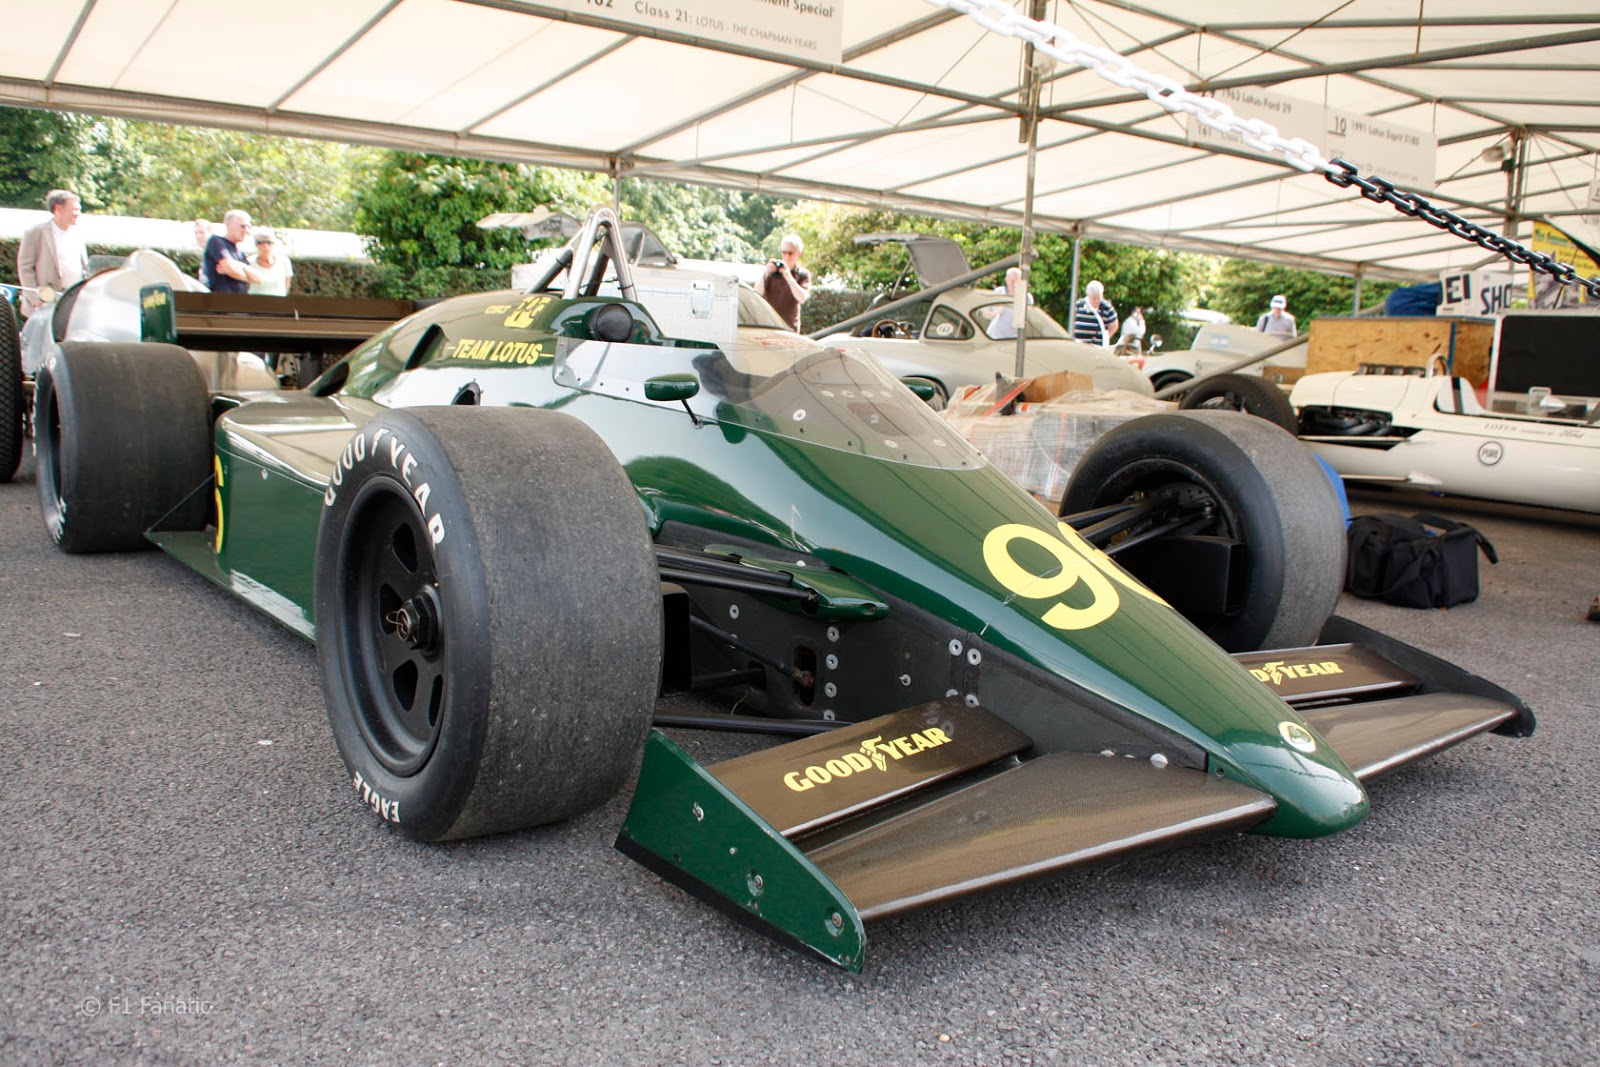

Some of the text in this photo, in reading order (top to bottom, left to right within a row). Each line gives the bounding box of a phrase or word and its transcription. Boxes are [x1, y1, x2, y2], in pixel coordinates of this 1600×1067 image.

[634, 0, 670, 19] Class
[696, 16, 724, 31] LOTUS
[733, 23, 748, 37] THE
[750, 27, 792, 45] CHAPMAN
[794, 38, 818, 51] YEARS
[452, 338, 543, 365] TEAM LOTUS
